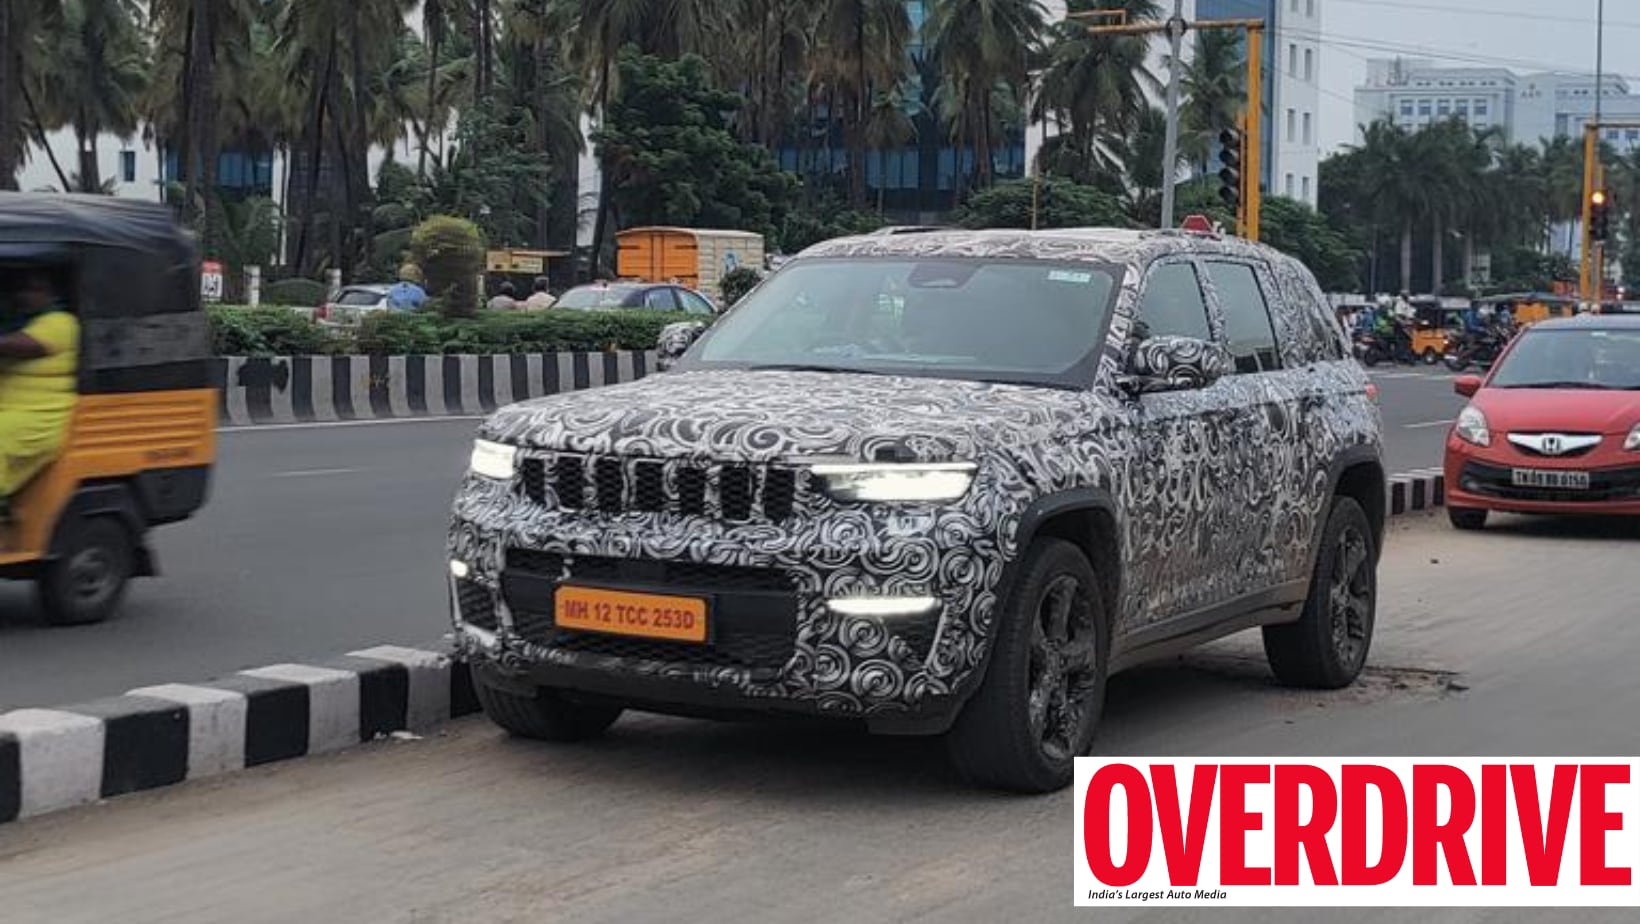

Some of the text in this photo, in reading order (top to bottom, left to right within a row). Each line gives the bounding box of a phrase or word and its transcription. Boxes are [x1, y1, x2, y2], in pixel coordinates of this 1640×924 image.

[564, 599, 588, 619] MH
[593, 603, 612, 622] 12
[616, 605, 649, 625] TCC
